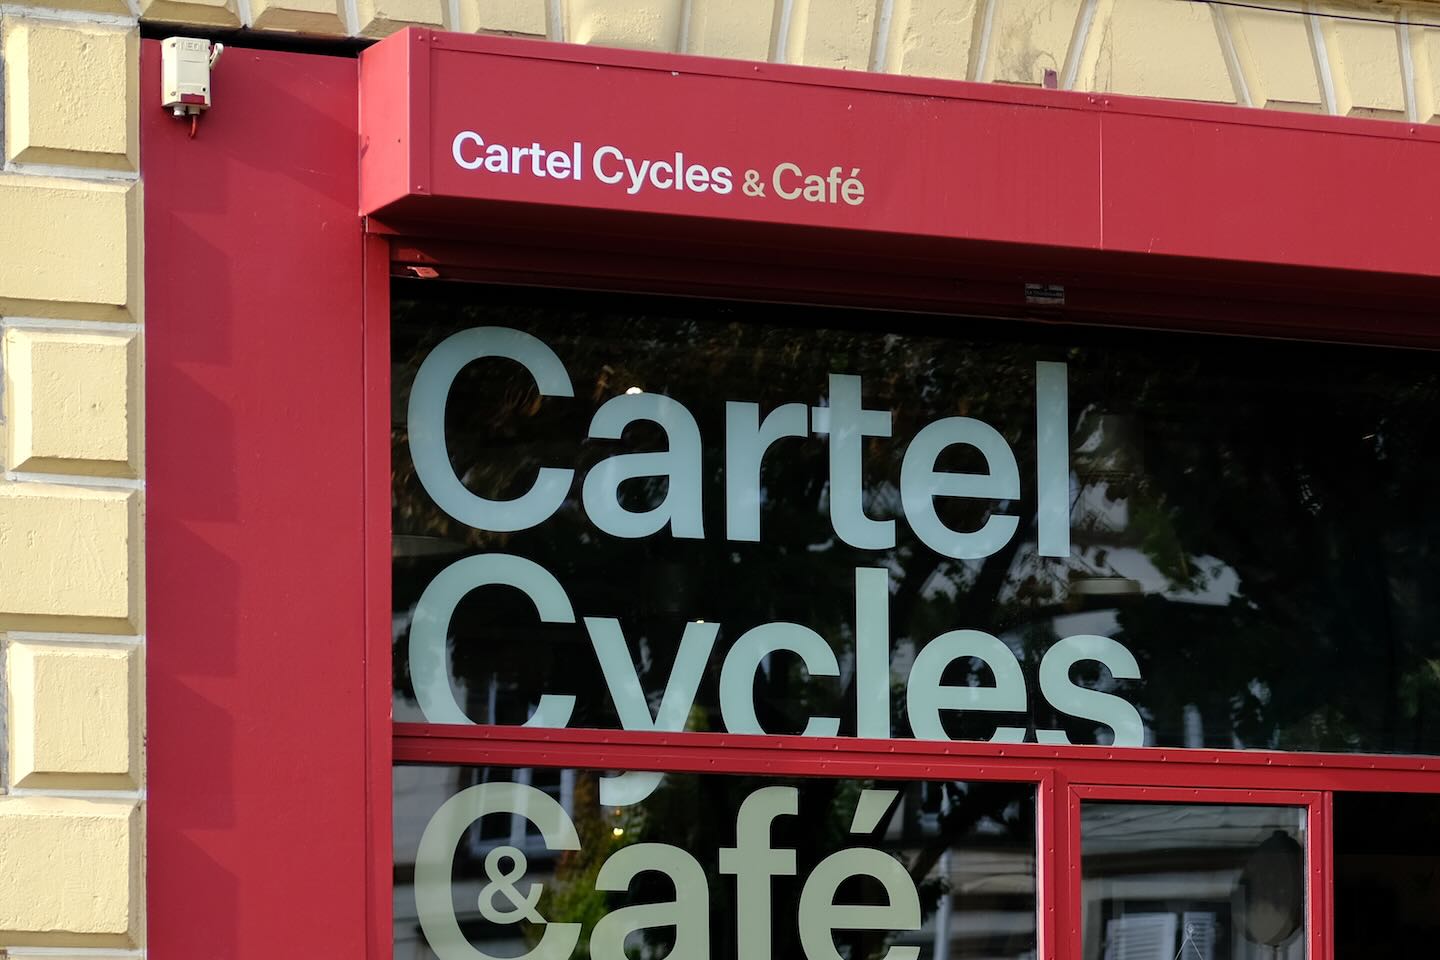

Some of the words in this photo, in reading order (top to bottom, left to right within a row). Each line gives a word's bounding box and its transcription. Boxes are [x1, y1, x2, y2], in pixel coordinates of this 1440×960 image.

[452, 130, 582, 180] Cartel
[592, 145, 733, 194] Cycles
[742, 169, 766, 197] &
[772, 163, 865, 205] Café
[407, 326, 1070, 559] Cartel
[408, 553, 1144, 806] Cycles
[478, 846, 548, 924] &
